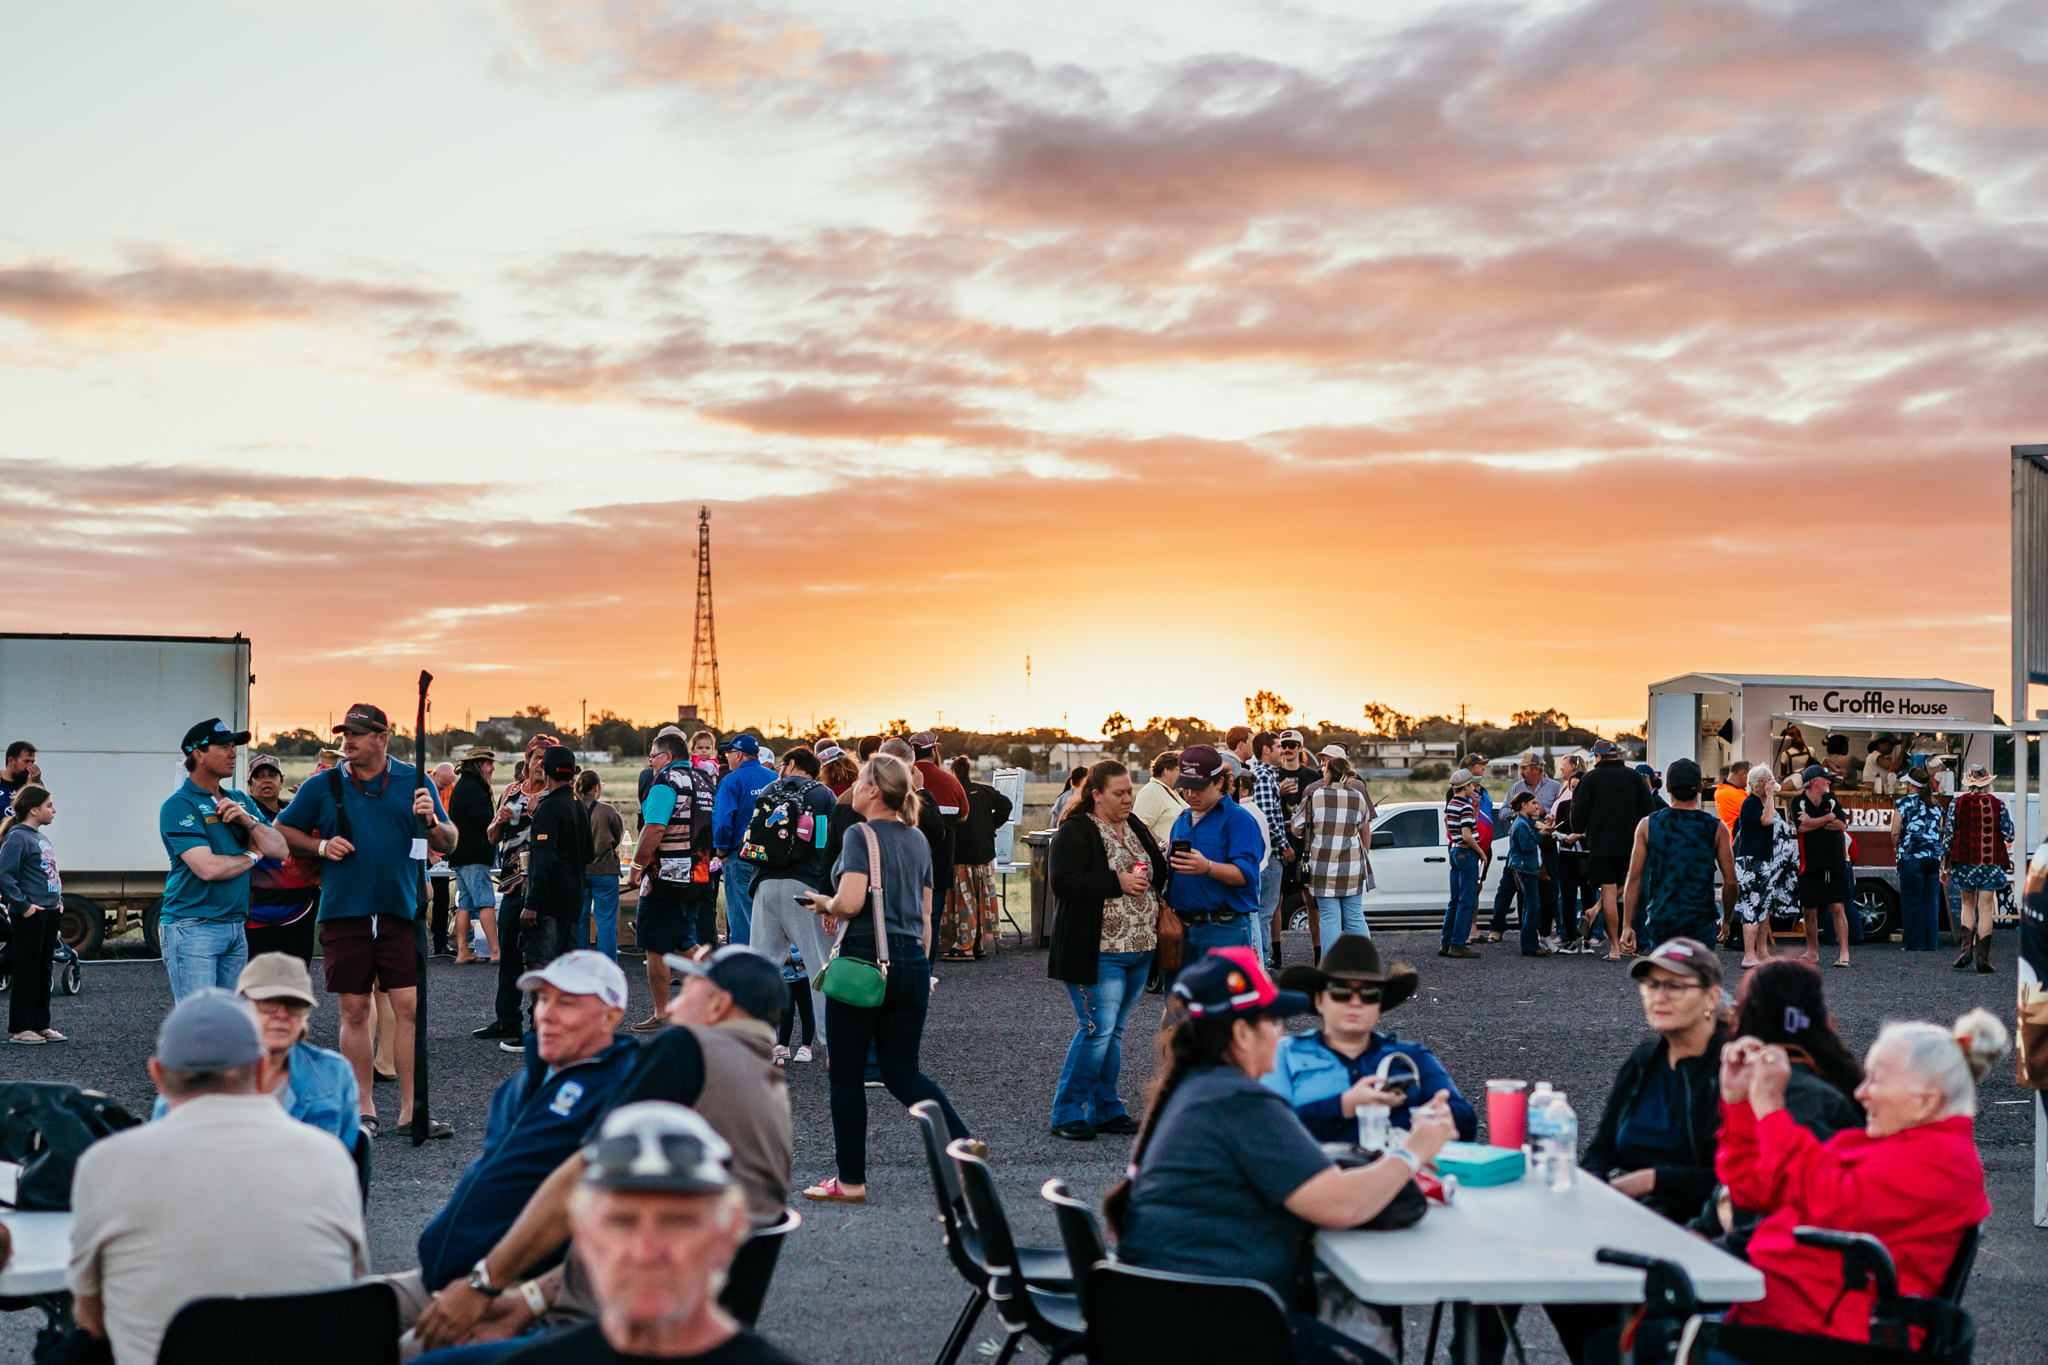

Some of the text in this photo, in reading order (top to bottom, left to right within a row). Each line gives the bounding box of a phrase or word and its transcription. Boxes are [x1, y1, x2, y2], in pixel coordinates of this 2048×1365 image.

[1789, 691, 1947, 715] The Croffle House
[1842, 808, 1895, 826] ROF
